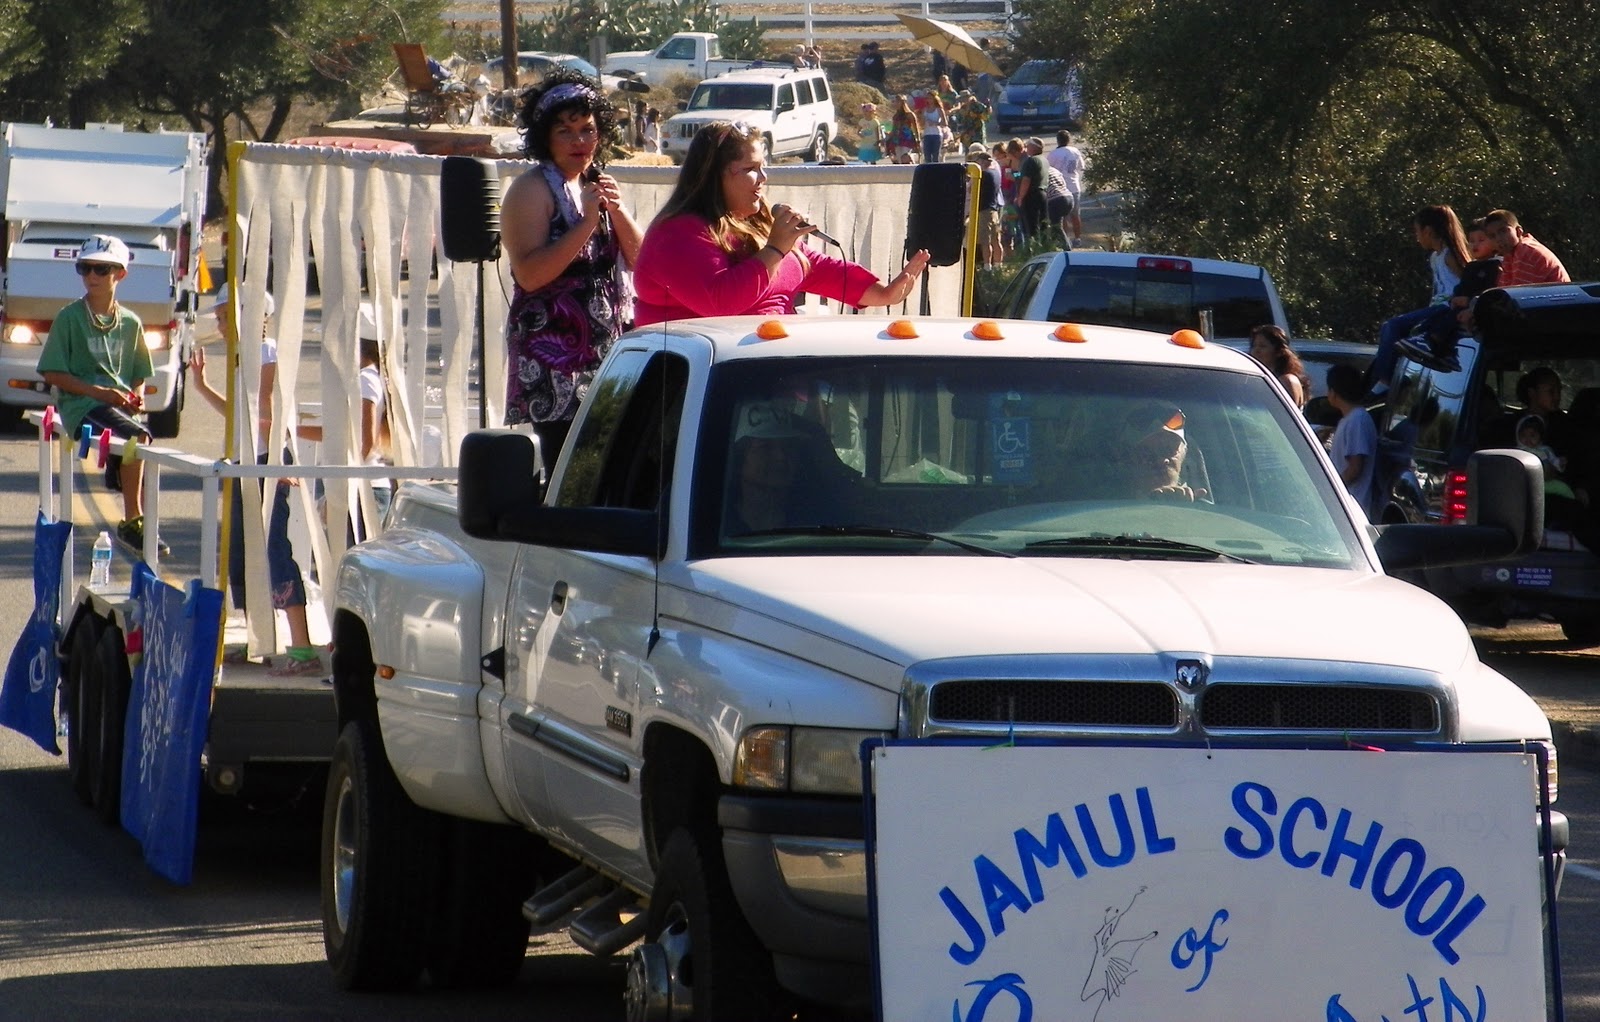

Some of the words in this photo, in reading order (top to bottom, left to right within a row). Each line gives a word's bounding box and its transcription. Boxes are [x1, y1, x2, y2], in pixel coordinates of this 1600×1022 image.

[936, 785, 1177, 968] JAMUL
[1222, 780, 1488, 967] SCHOOL
[1169, 908, 1230, 994] of
